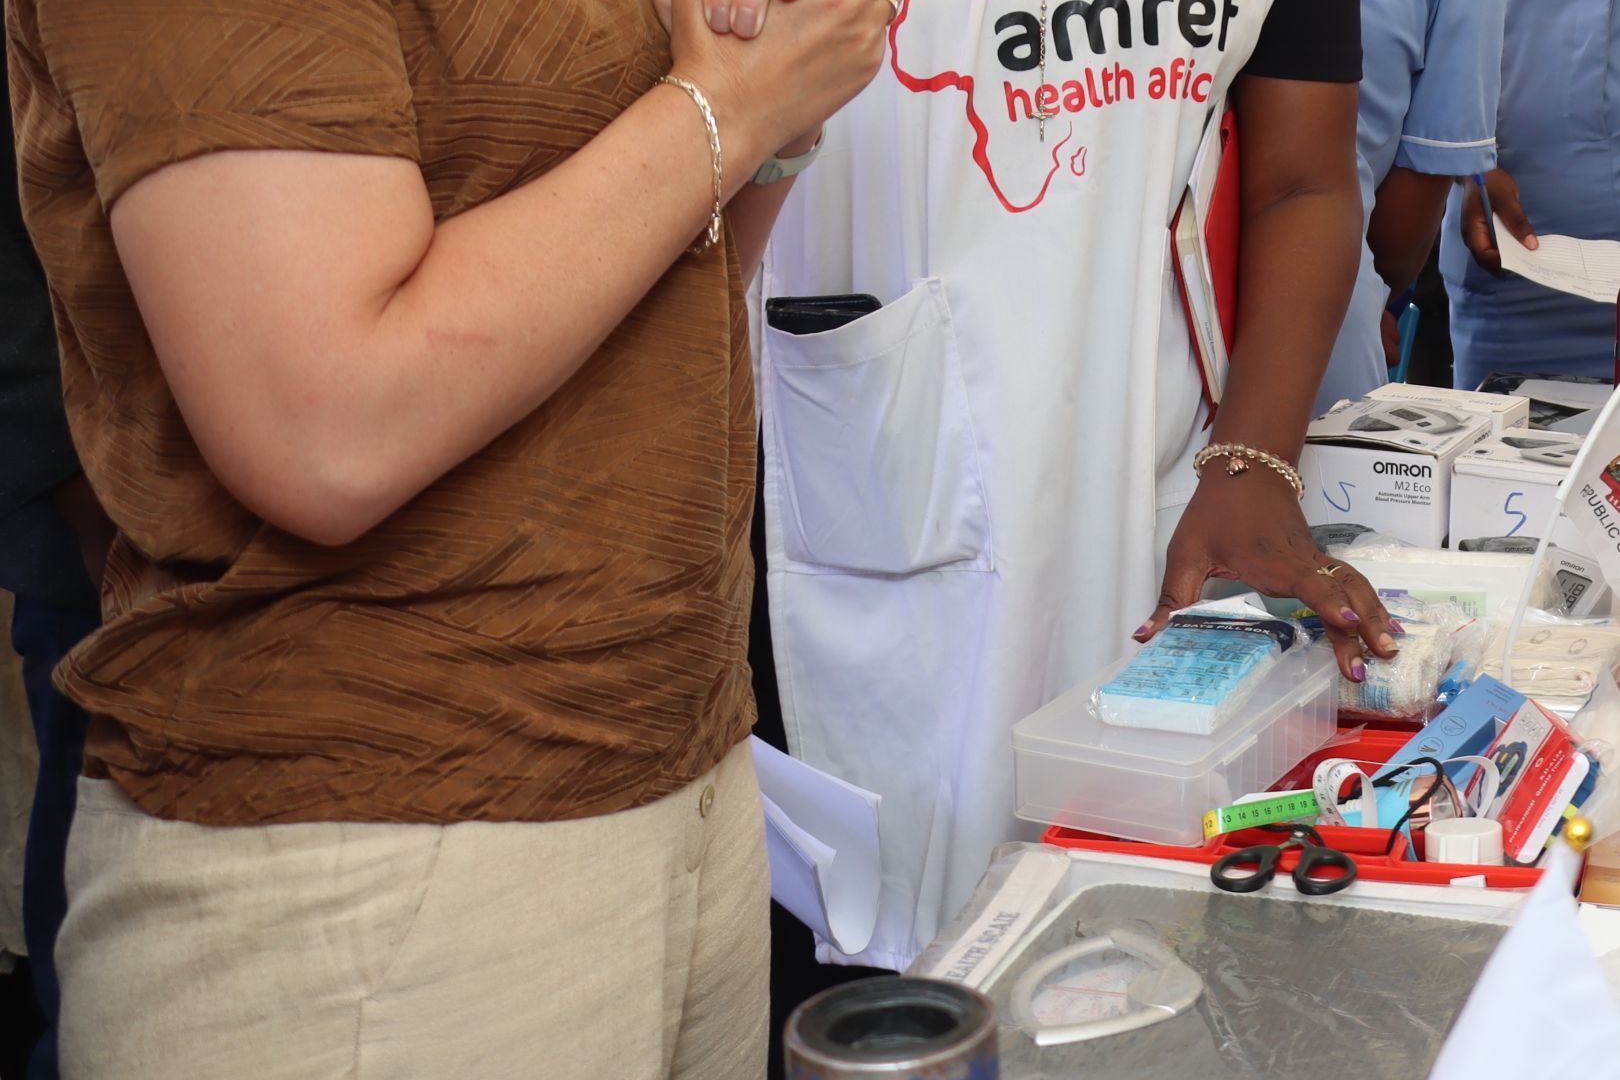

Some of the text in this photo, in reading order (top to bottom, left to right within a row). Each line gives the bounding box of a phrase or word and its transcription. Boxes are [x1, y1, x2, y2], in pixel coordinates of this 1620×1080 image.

[1003, 61, 1135, 123] health
[1373, 461, 1432, 478] OMRON
[1394, 480, 1432, 493] M2 Eco
[1245, 627, 1271, 635] BOX
[1205, 819, 1213, 829] 12
[1222, 814, 1232, 824] 13
[1238, 812, 1246, 821] 14
[1252, 809, 1259, 818] 15
[1264, 807, 1272, 816] 16
[1276, 804, 1283, 813] 17
[1288, 802, 1296, 811] 18
[1300, 800, 1308, 809] 19
